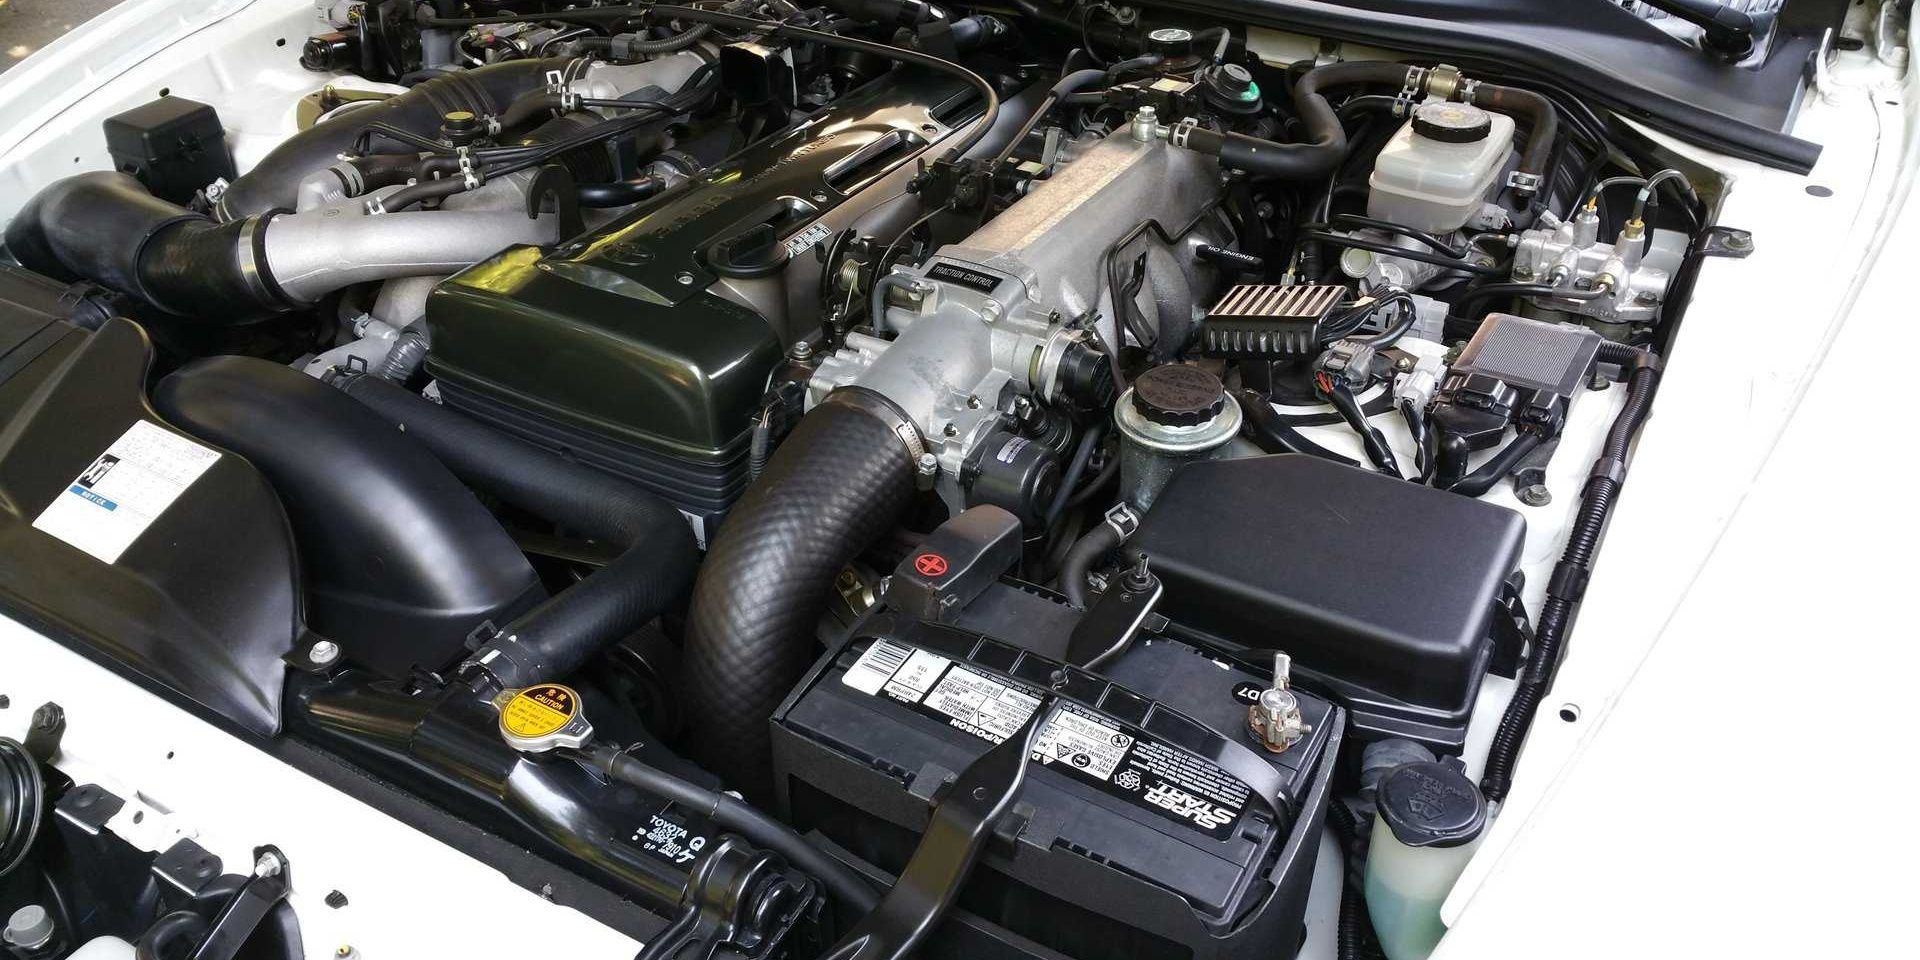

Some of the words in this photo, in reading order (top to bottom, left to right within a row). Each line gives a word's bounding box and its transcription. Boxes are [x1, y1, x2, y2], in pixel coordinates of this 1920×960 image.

[933, 266, 965, 279] TRACTION
[963, 273, 994, 287] CONTROL
[535, 694, 565, 710] CAUTION
[1237, 687, 1260, 701] D7
[1144, 791, 1217, 829] SUPER
[1148, 785, 1237, 825] START
[650, 815, 688, 839] TOYOTA
[689, 836, 706, 851] Q
